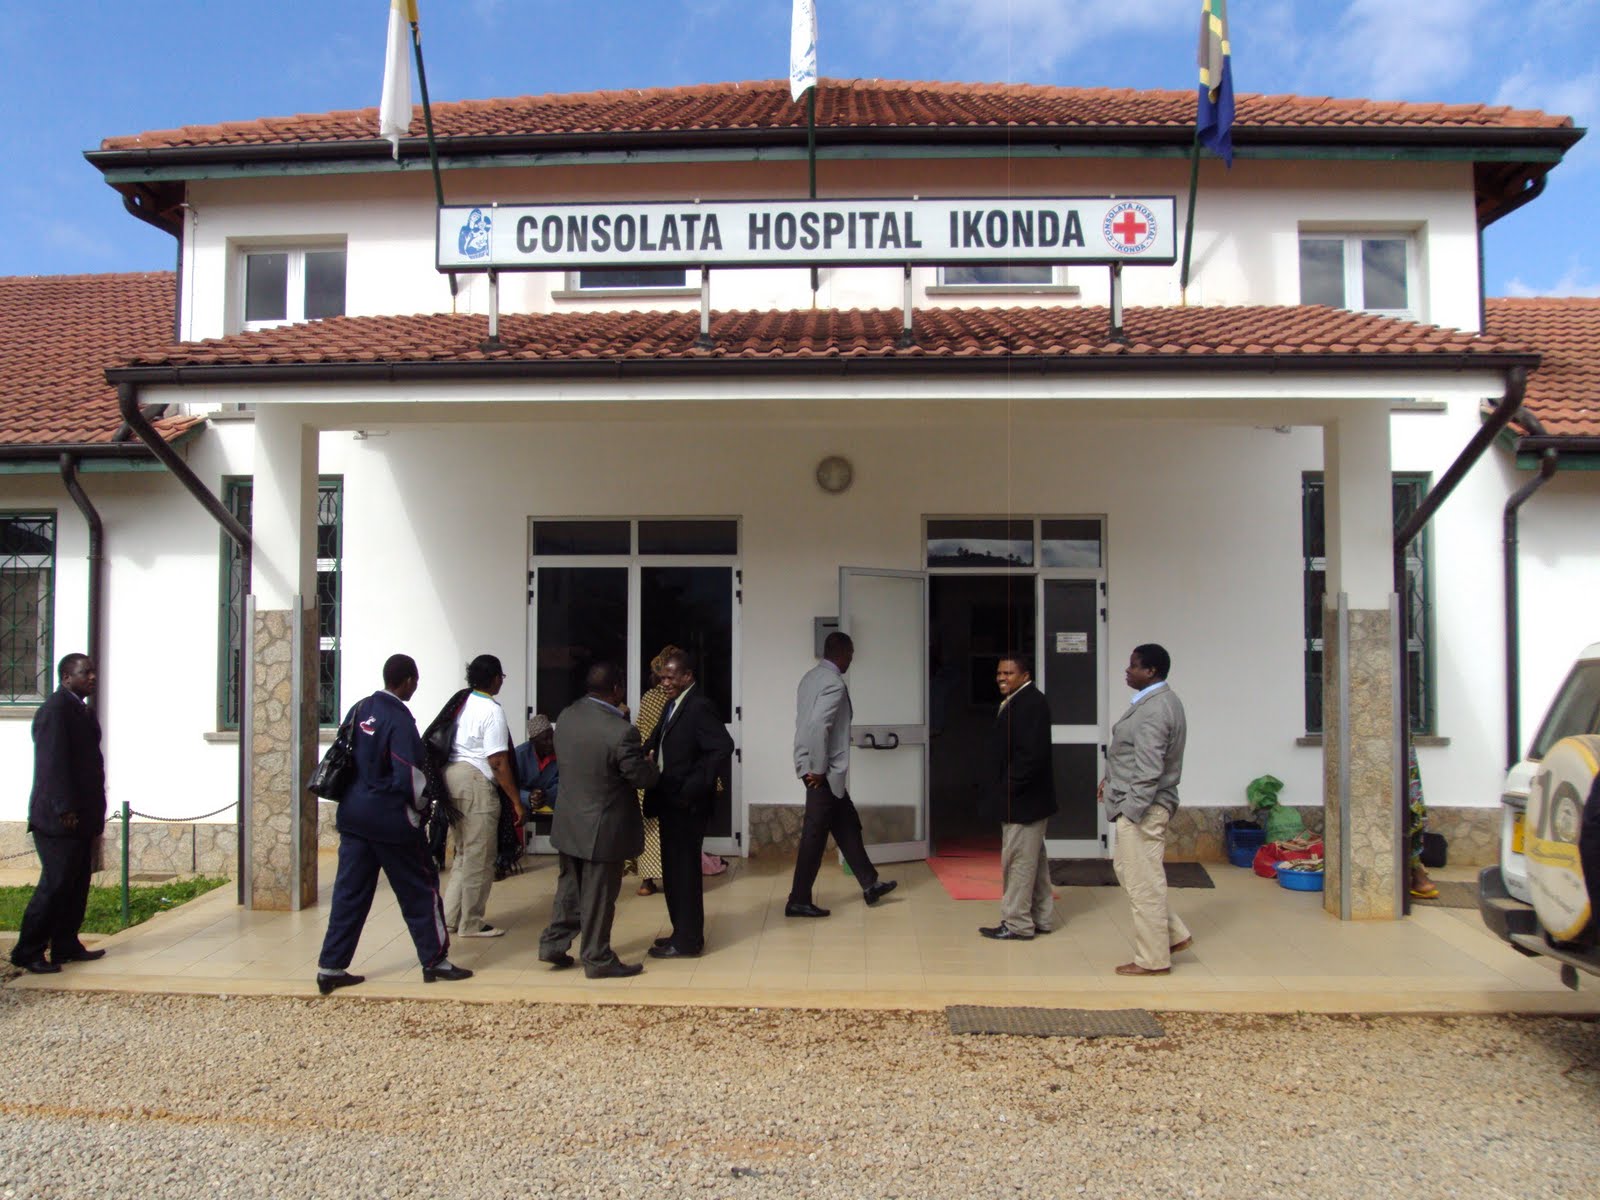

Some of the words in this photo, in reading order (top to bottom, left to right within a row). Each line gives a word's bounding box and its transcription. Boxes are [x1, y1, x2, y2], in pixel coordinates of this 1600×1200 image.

[516, 213, 723, 254] CONSOLATA
[748, 211, 922, 251] HOSPITAL
[949, 209, 1086, 248] IKONDA
[1104, 203, 1133, 241] CONSOLATA
[1135, 204, 1156, 240] HOSPITAL
[1114, 243, 1146, 253] IKONDA
